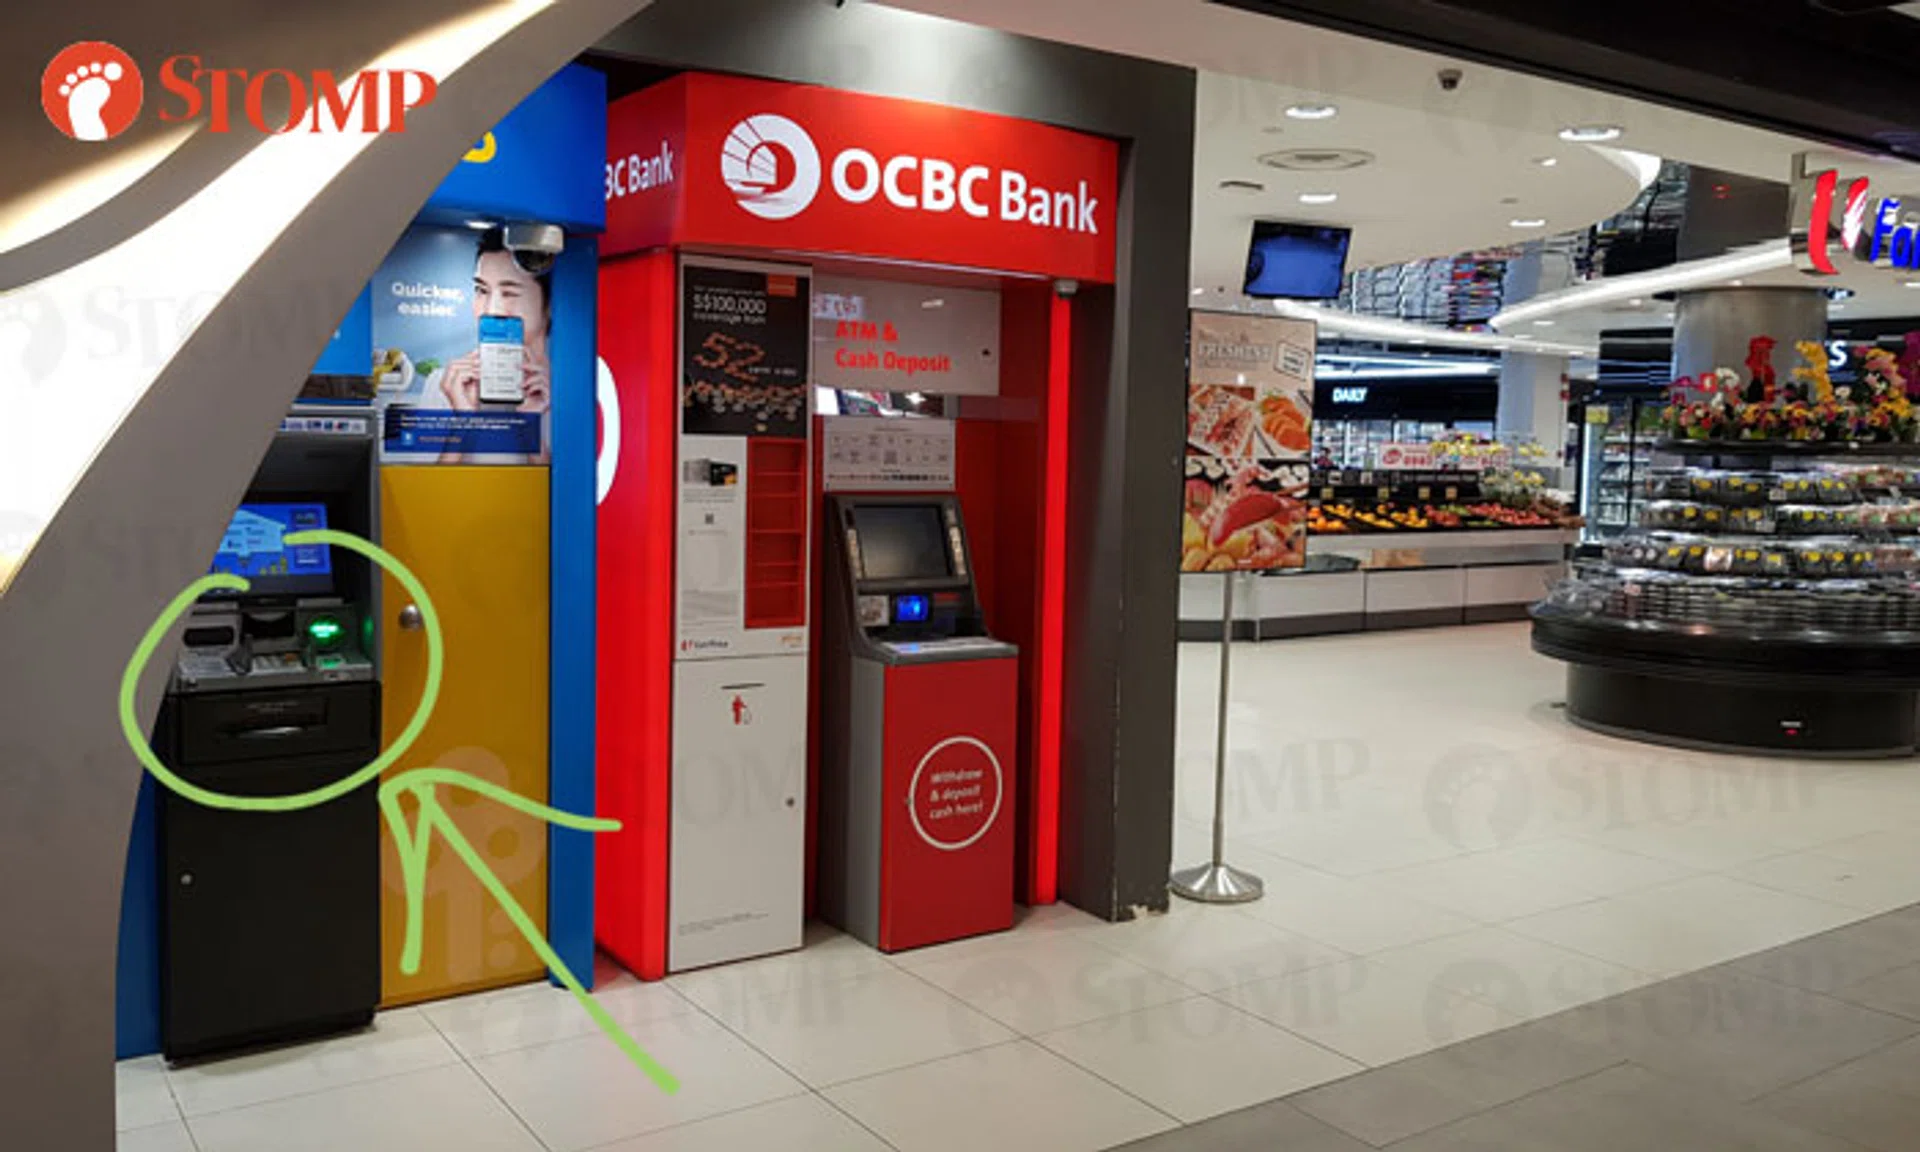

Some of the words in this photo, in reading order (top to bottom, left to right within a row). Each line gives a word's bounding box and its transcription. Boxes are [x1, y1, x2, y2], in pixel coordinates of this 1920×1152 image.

[606, 158, 626, 201] BC
[628, 140, 674, 194] Bank
[831, 147, 990, 218] OCBC
[1000, 169, 1099, 235] Bank
[835, 320, 878, 341] ATM
[882, 321, 899, 342] &
[693, 331, 766, 382] 52
[834, 347, 879, 370] Cash
[882, 351, 951, 377] Deposit
[1332, 387, 1368, 403] DAILY
